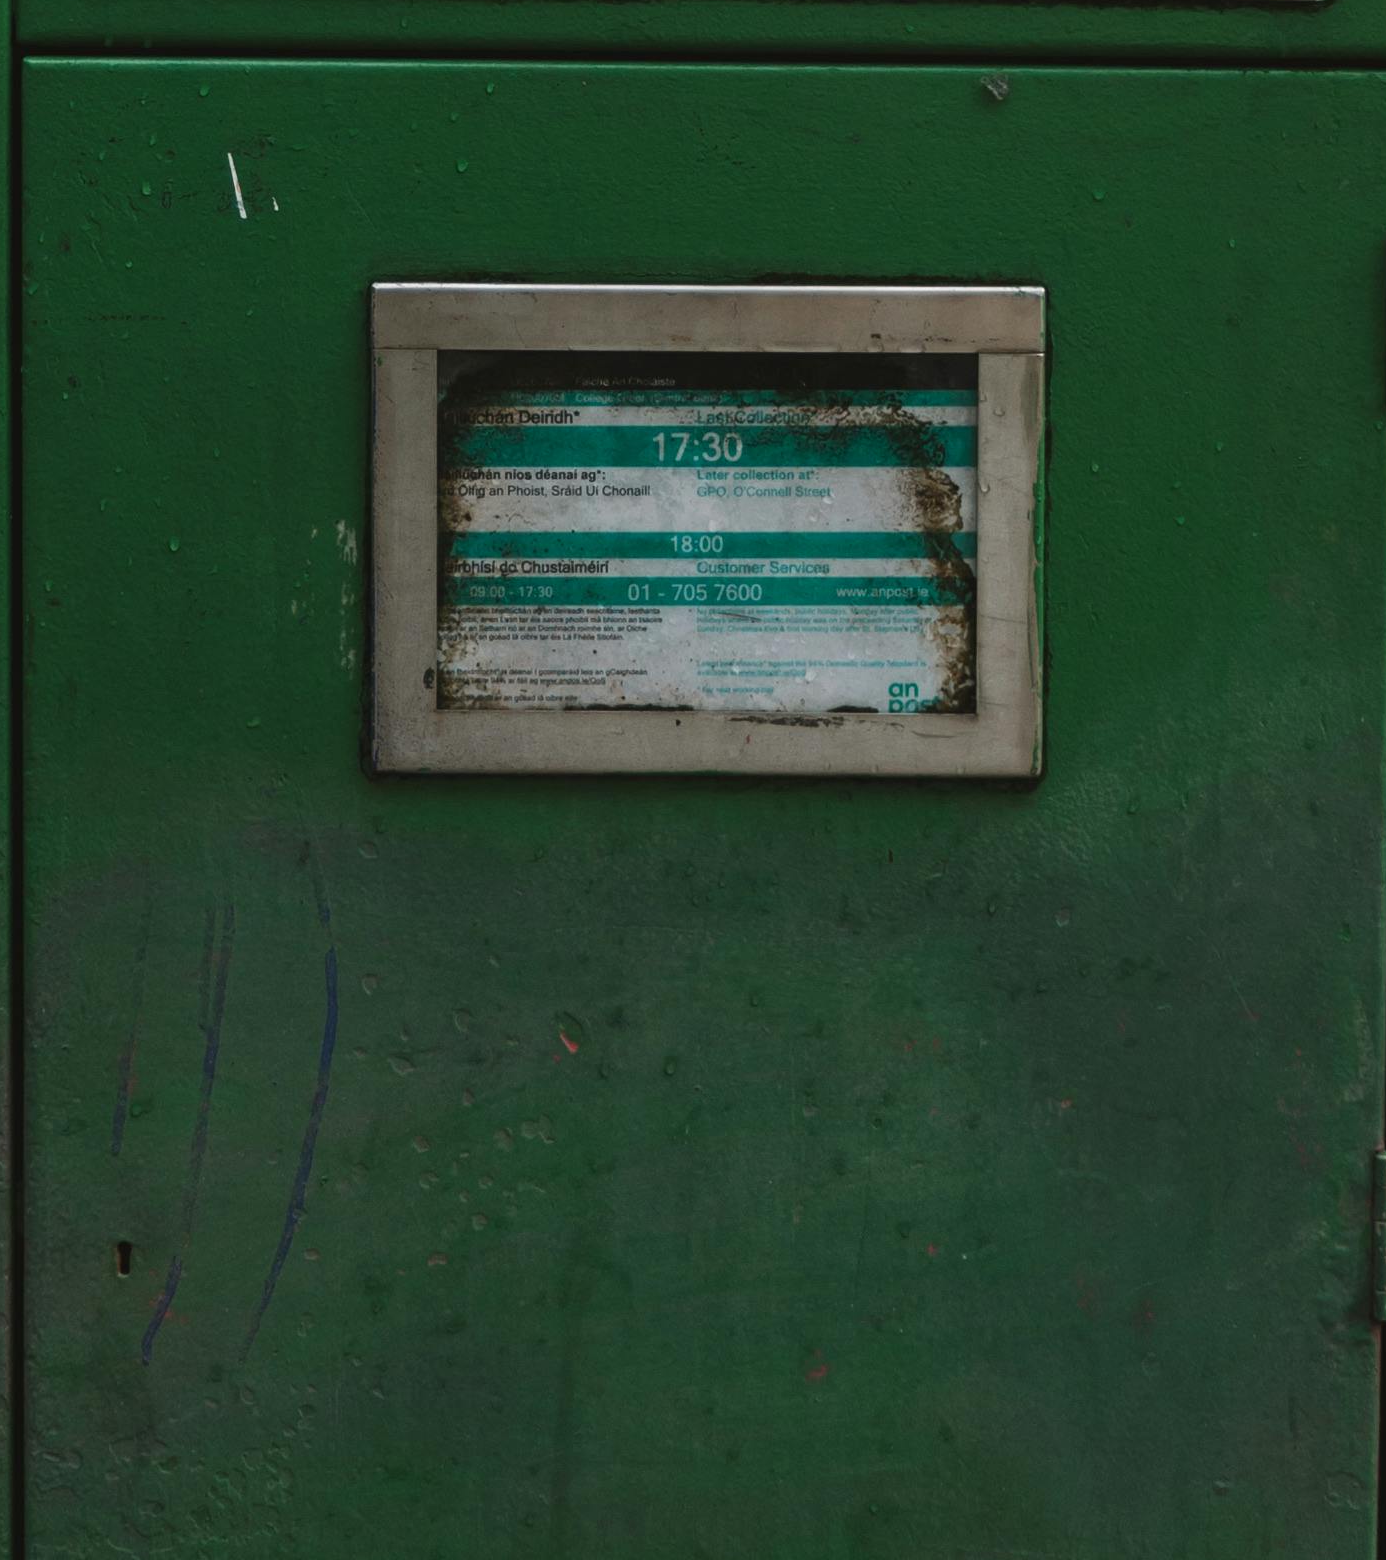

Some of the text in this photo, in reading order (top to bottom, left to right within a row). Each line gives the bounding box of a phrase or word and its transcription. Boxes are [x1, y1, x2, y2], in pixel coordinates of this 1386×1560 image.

[652, 432, 743, 462] 17:30
[697, 470, 728, 481] Later
[733, 470, 794, 481] collection
[489, 487, 504, 497] an
[507, 485, 548, 499] Phoist,
[551, 484, 583, 497] Sráid
[586, 485, 599, 497] Uí
[602, 485, 651, 497] Chonaill
[733, 486, 792, 497] O'Connell
[795, 486, 831, 497] Street
[671, 536, 724, 553] 18:00
[446, 560, 496, 574] eirbhísí
[521, 560, 609, 574] Chustaiméirí
[697, 561, 831, 574] Customer Services
[519, 586, 553, 598] 17:30
[627, 584, 650, 601] 01
[671, 584, 707, 601] 705
[714, 584, 762, 601] 7600
[836, 587, 929, 599] www.anpost.ie
[888, 682, 919, 698] an
